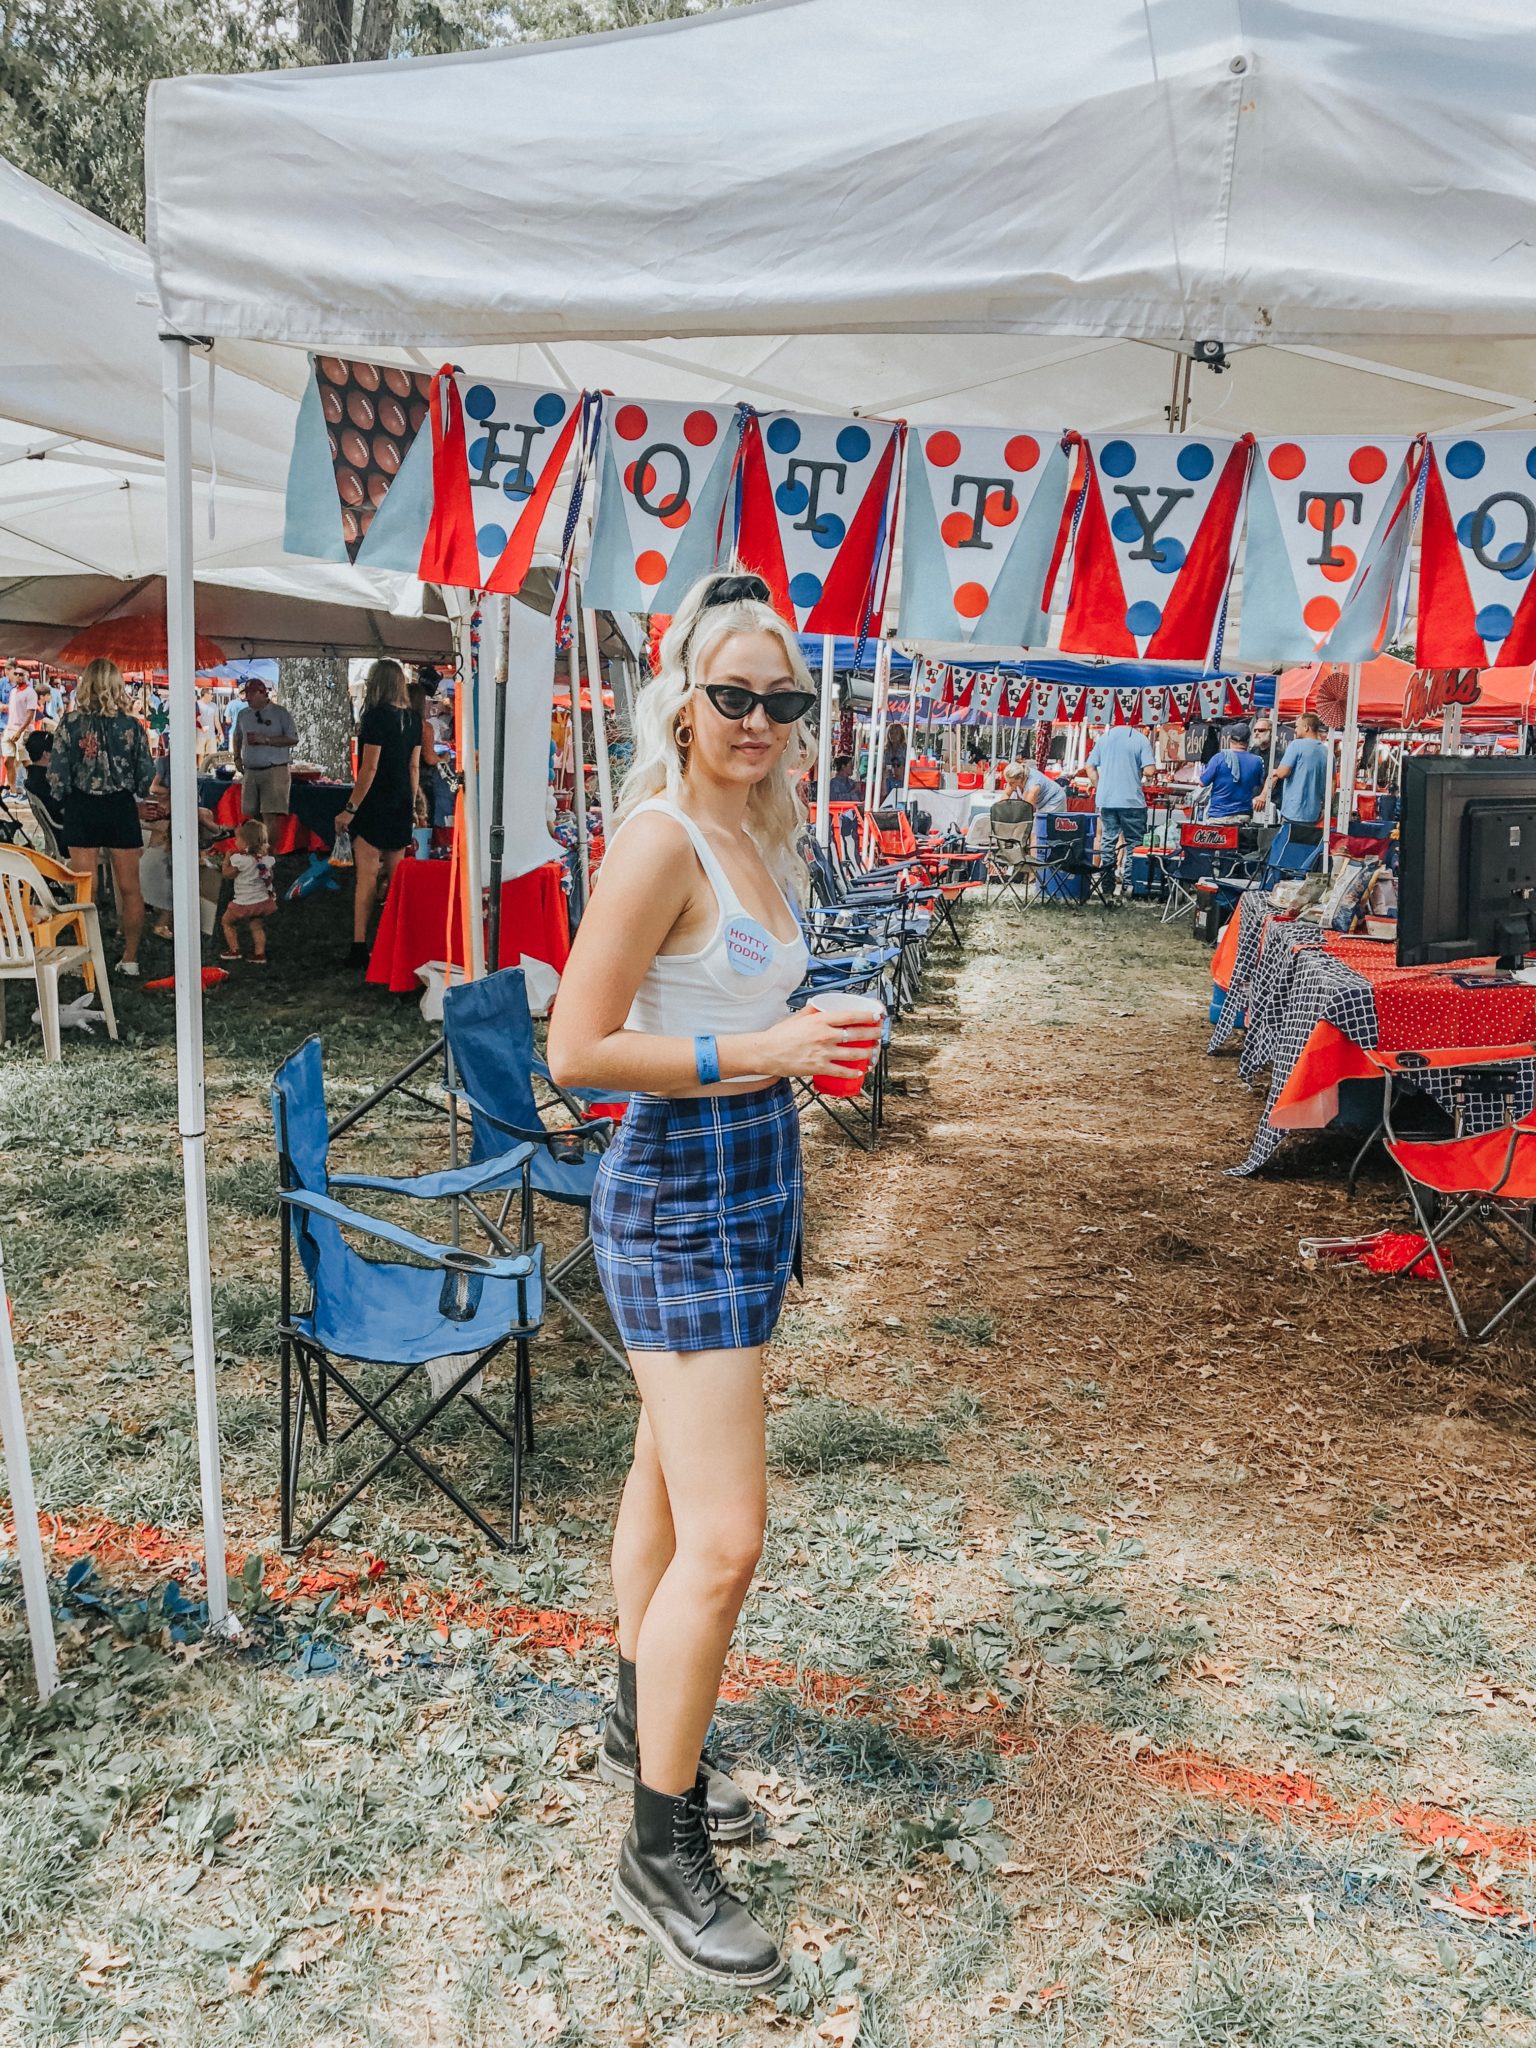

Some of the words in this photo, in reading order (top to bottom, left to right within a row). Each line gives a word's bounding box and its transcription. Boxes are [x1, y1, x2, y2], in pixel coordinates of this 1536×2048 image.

[1193, 829, 1207, 843] Ole
[1206, 830, 1227, 844] Miss
[728, 939, 767, 964] TODDY
[730, 927, 768, 952] HOTTY
